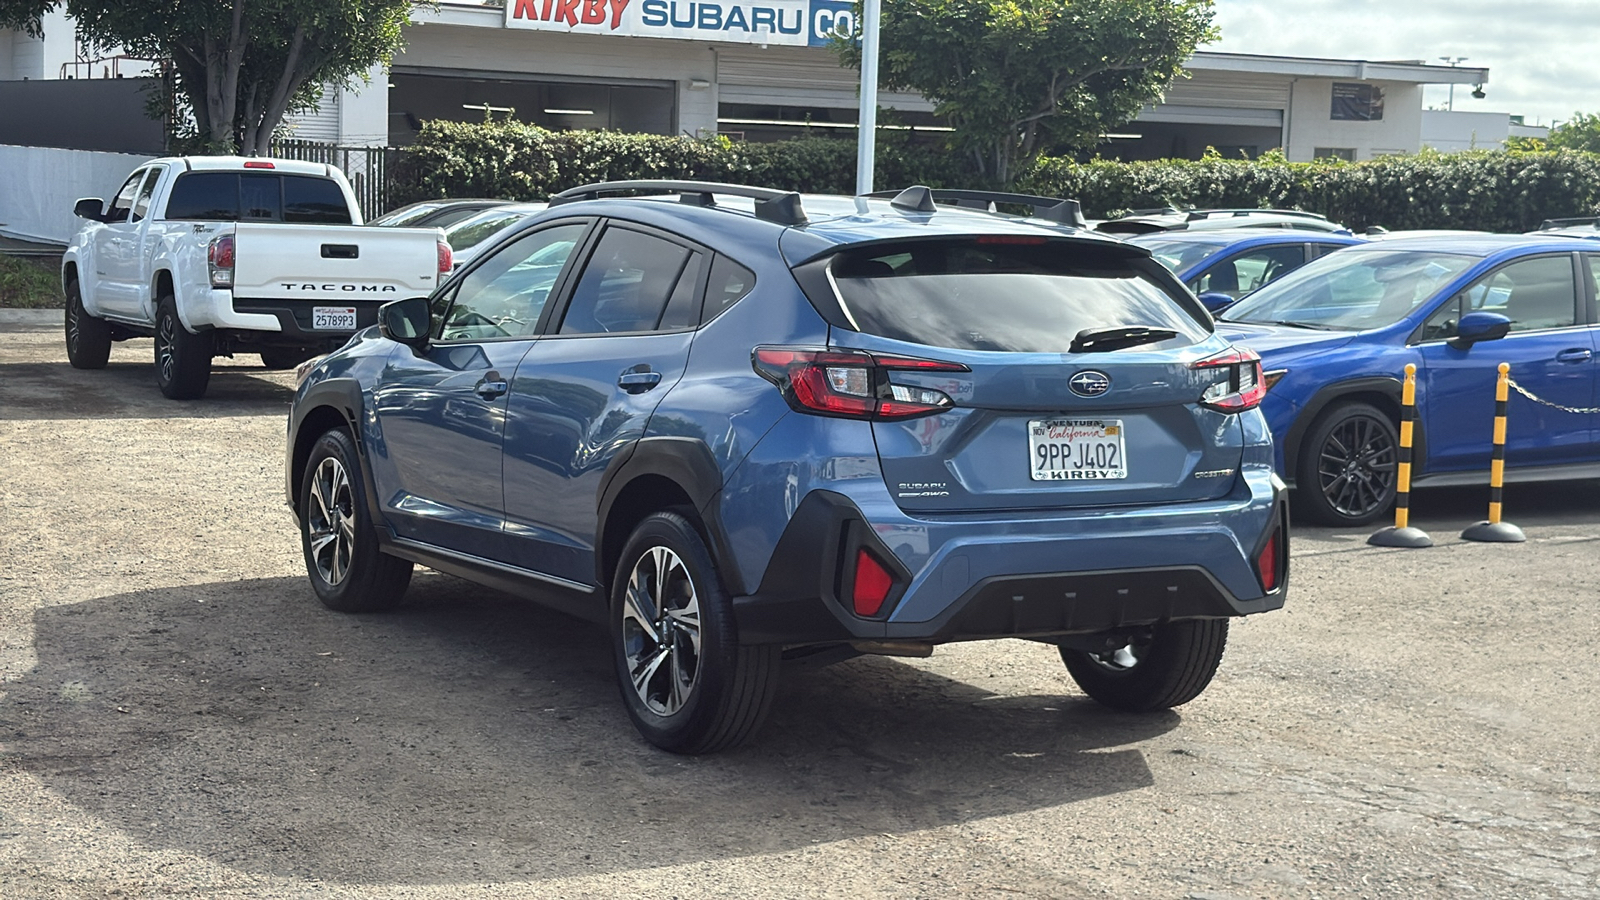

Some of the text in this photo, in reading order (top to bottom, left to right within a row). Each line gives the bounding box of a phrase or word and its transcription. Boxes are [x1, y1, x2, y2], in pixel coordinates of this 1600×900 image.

[642, 0, 802, 35] SUBARU
[281, 283, 396, 292] TACOMA
[316, 315, 354, 326] 25789P3
[1033, 427, 1045, 436] NOV
[1049, 427, 1106, 442] California
[1051, 470, 1109, 479] KIRBY
